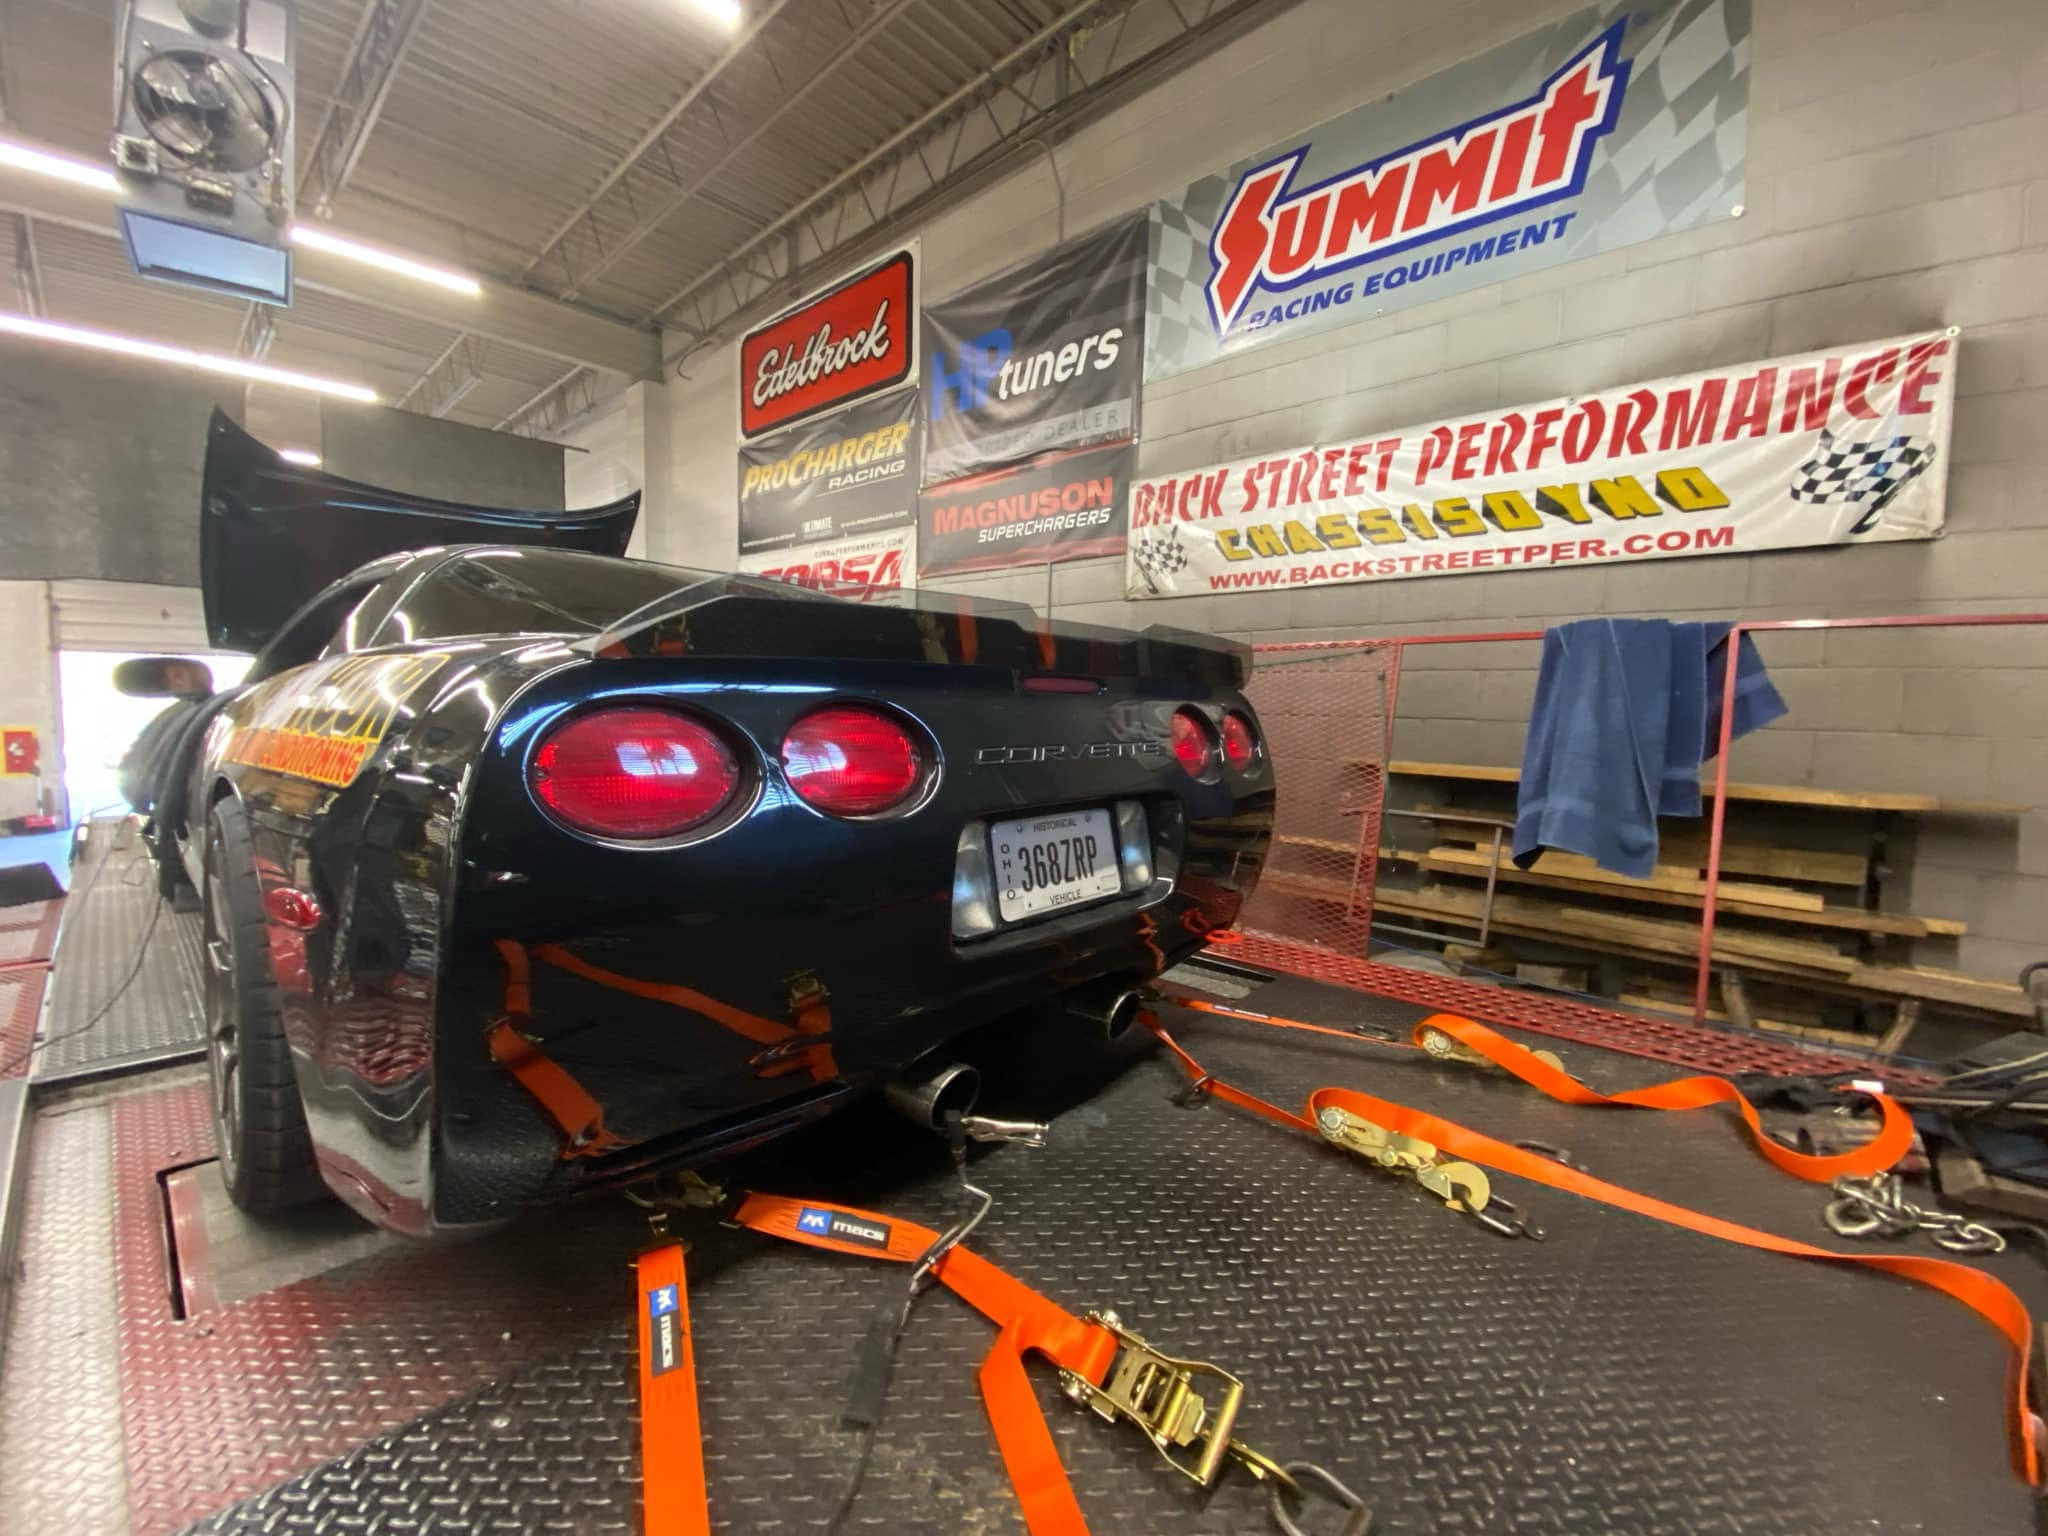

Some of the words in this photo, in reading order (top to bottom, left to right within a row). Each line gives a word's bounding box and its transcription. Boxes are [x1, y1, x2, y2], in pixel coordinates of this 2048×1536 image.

[1248, 282, 1353, 331] RACING
[1363, 212, 1577, 297] EQUIPMENT
[753, 300, 890, 406] Edelbrock
[999, 328, 1123, 400] tuners
[1045, 408, 1119, 441] DEALER
[1132, 469, 1229, 530] BACK
[1240, 437, 1402, 513] STREET
[1415, 340, 1950, 485] PERFORMANCE
[828, 460, 905, 490] RACING
[933, 477, 1113, 536] MAGNUSON
[978, 508, 1112, 543] SUPERCHARGERS
[1210, 526, 1735, 590] WWW.BACKSTREETPER.COM
[975, 741, 1161, 765] CORVETTE
[1033, 817, 1077, 833] HISTORICAL
[1018, 835, 1098, 892] 368ZRP
[1050, 889, 1082, 906] VEHICLE
